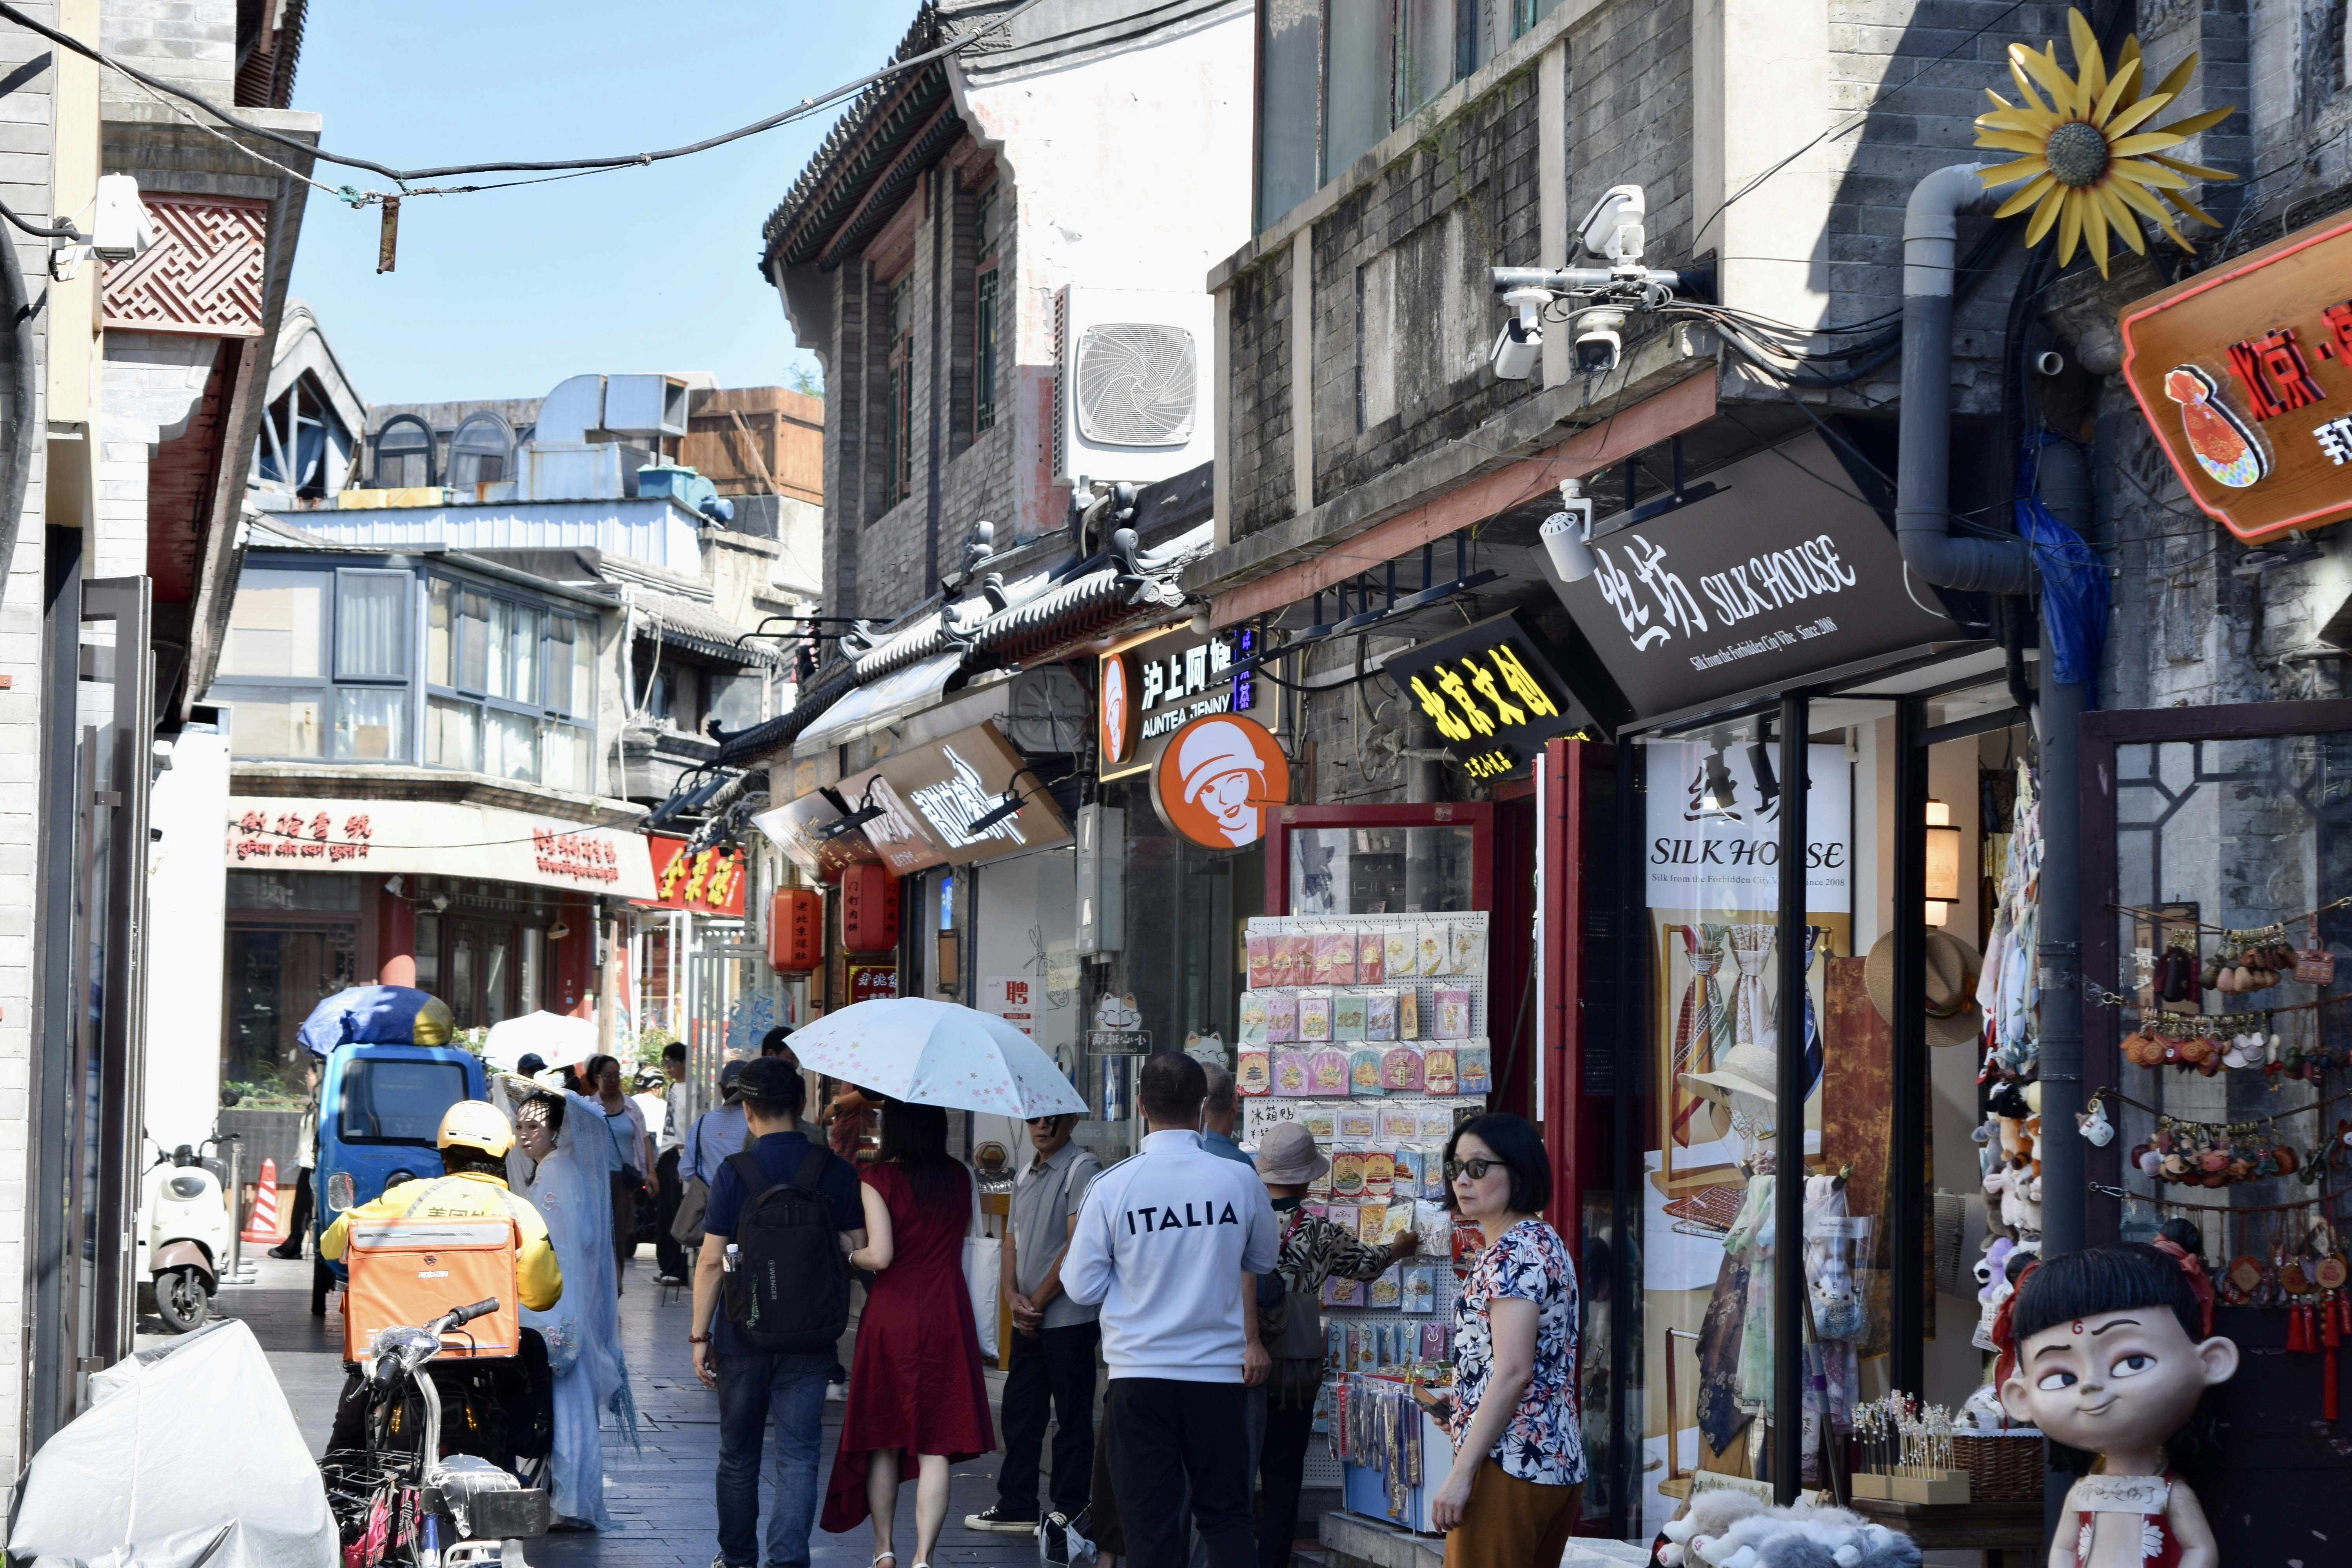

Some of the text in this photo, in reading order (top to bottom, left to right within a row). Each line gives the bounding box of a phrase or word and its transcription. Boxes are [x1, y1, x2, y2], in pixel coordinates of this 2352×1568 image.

[1594, 534, 1708, 651] 丝坊
[1700, 534, 1856, 626] SILK HOUSE
[1690, 617, 1838, 671] Silk from the Forbidden City Vibe Since 2008
[1142, 637, 1231, 710] 沪上阿姨
[1411, 644, 1558, 741] 北京文创
[1142, 708, 1186, 739] AUNTEA
[1651, 838, 1845, 869] SILK HOSE
[1753, 877, 1770, 886] City
[846, 881, 860, 933] 门钉肉饼
[795, 901, 809, 961] 老北京爆肚
[1006, 981, 1029, 1004] 聘
[1251, 1105, 1294, 1125] 冰箱贴
[1127, 1201, 1239, 1235] ITALIA
[769, 1267, 777, 1300] WENGER
